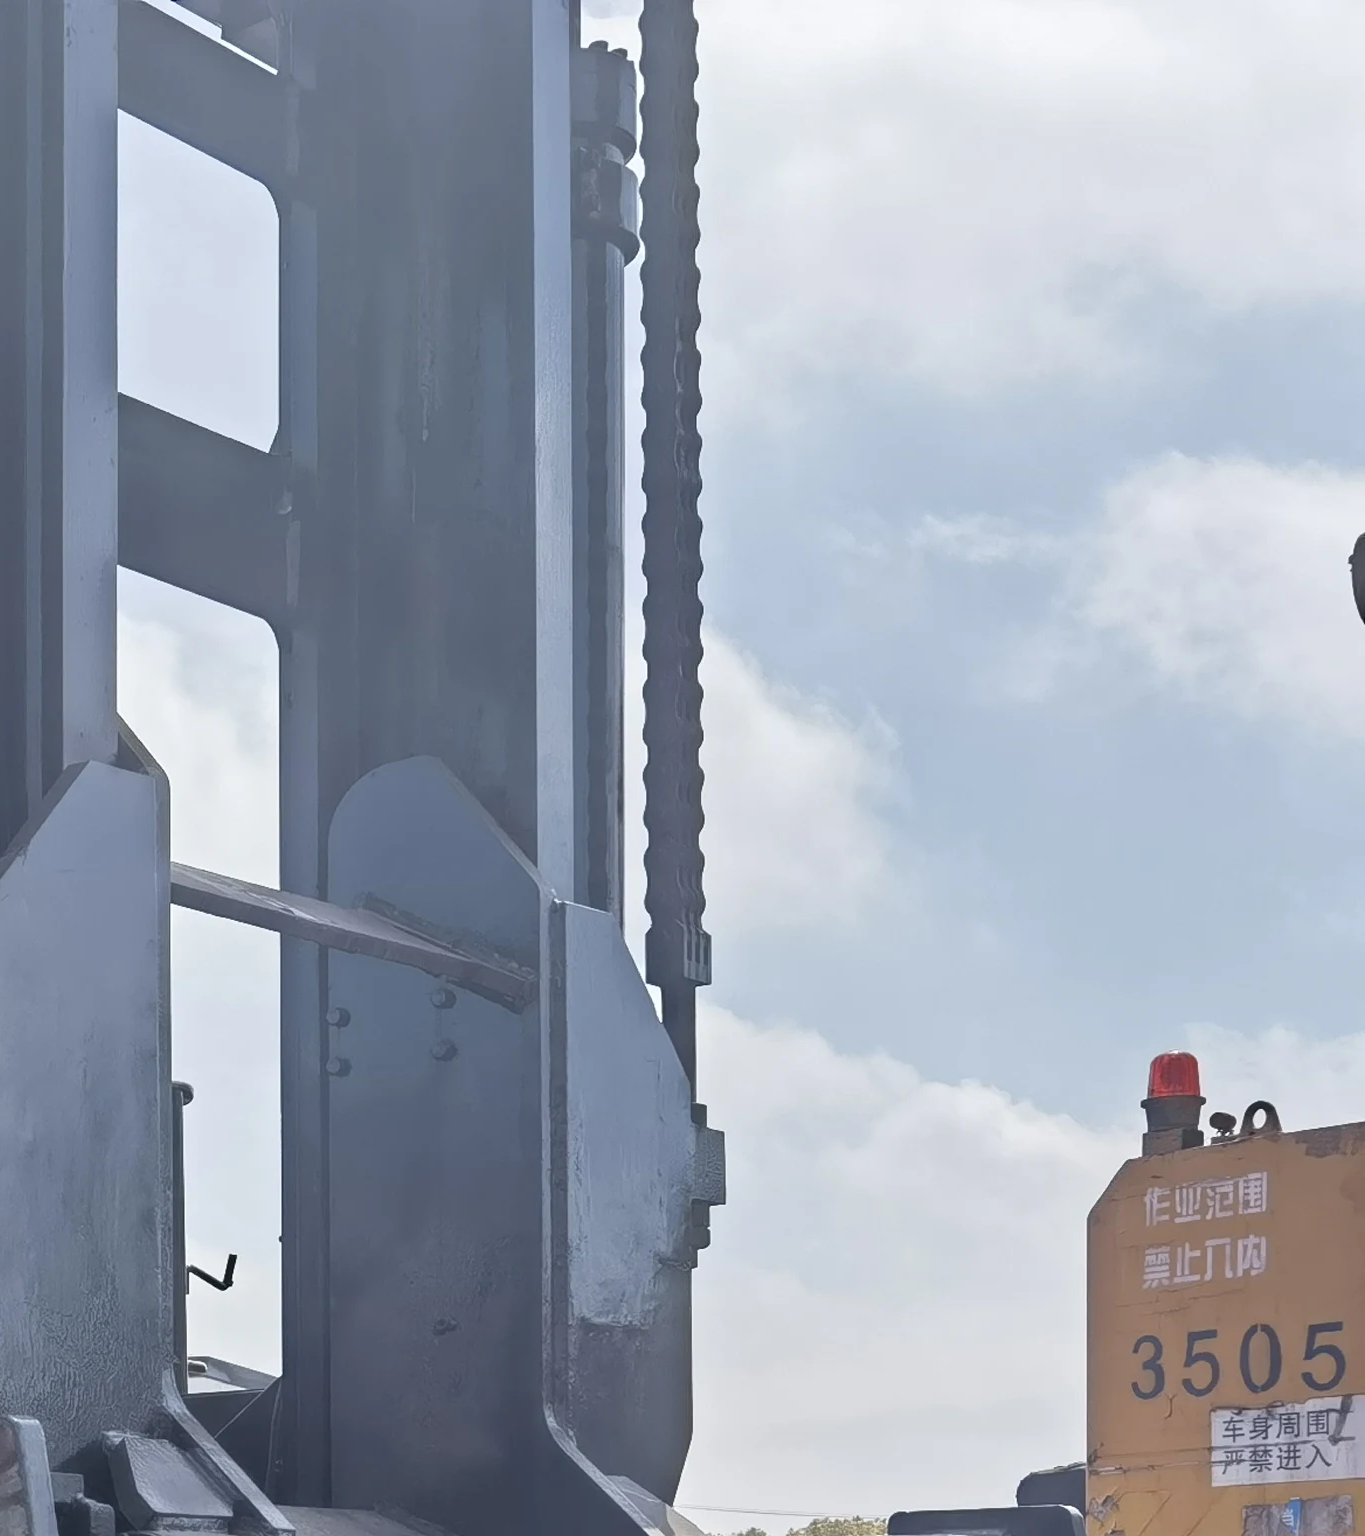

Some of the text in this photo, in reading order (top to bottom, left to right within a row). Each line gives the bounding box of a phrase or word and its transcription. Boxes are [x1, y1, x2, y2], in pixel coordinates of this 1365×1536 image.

[1131, 1321, 1347, 1400] 3505
[1222, 1411, 1331, 1443] 车身周围
[1221, 1444, 1333, 1475] 严禁进入
